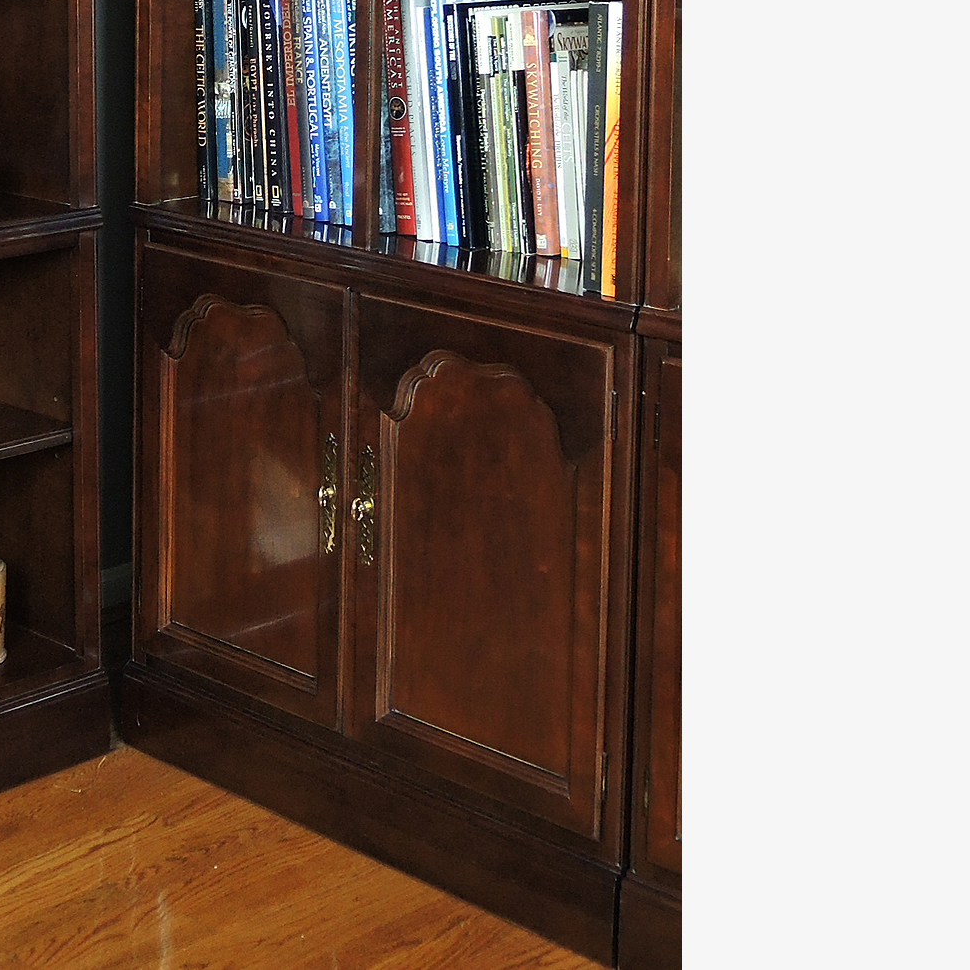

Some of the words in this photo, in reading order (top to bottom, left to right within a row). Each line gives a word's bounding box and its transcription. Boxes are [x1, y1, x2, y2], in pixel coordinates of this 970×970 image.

[194, 25, 204, 51] THE
[262, 3, 274, 73] JOURNEY
[283, 30, 294, 87] IMPERIO
[302, 16, 315, 54] SPAIN
[195, 54, 206, 97] CELTIC
[249, 58, 258, 91] EGYPT
[294, 36, 303, 84] FRANCE
[319, 38, 331, 91] ANCIENT
[333, 19, 349, 123] MESOPOTAMIA
[434, 50, 443, 85] SOUTH
[197, 100, 207, 147] WORLD
[267, 83, 275, 120] INTO
[306, 71, 318, 140] PORTUGAL
[322, 92, 332, 129] EGYPT
[526, 62, 543, 170] SKYWATCHING
[268, 129, 278, 178] CHINA
[441, 158, 450, 193] McIntyre
